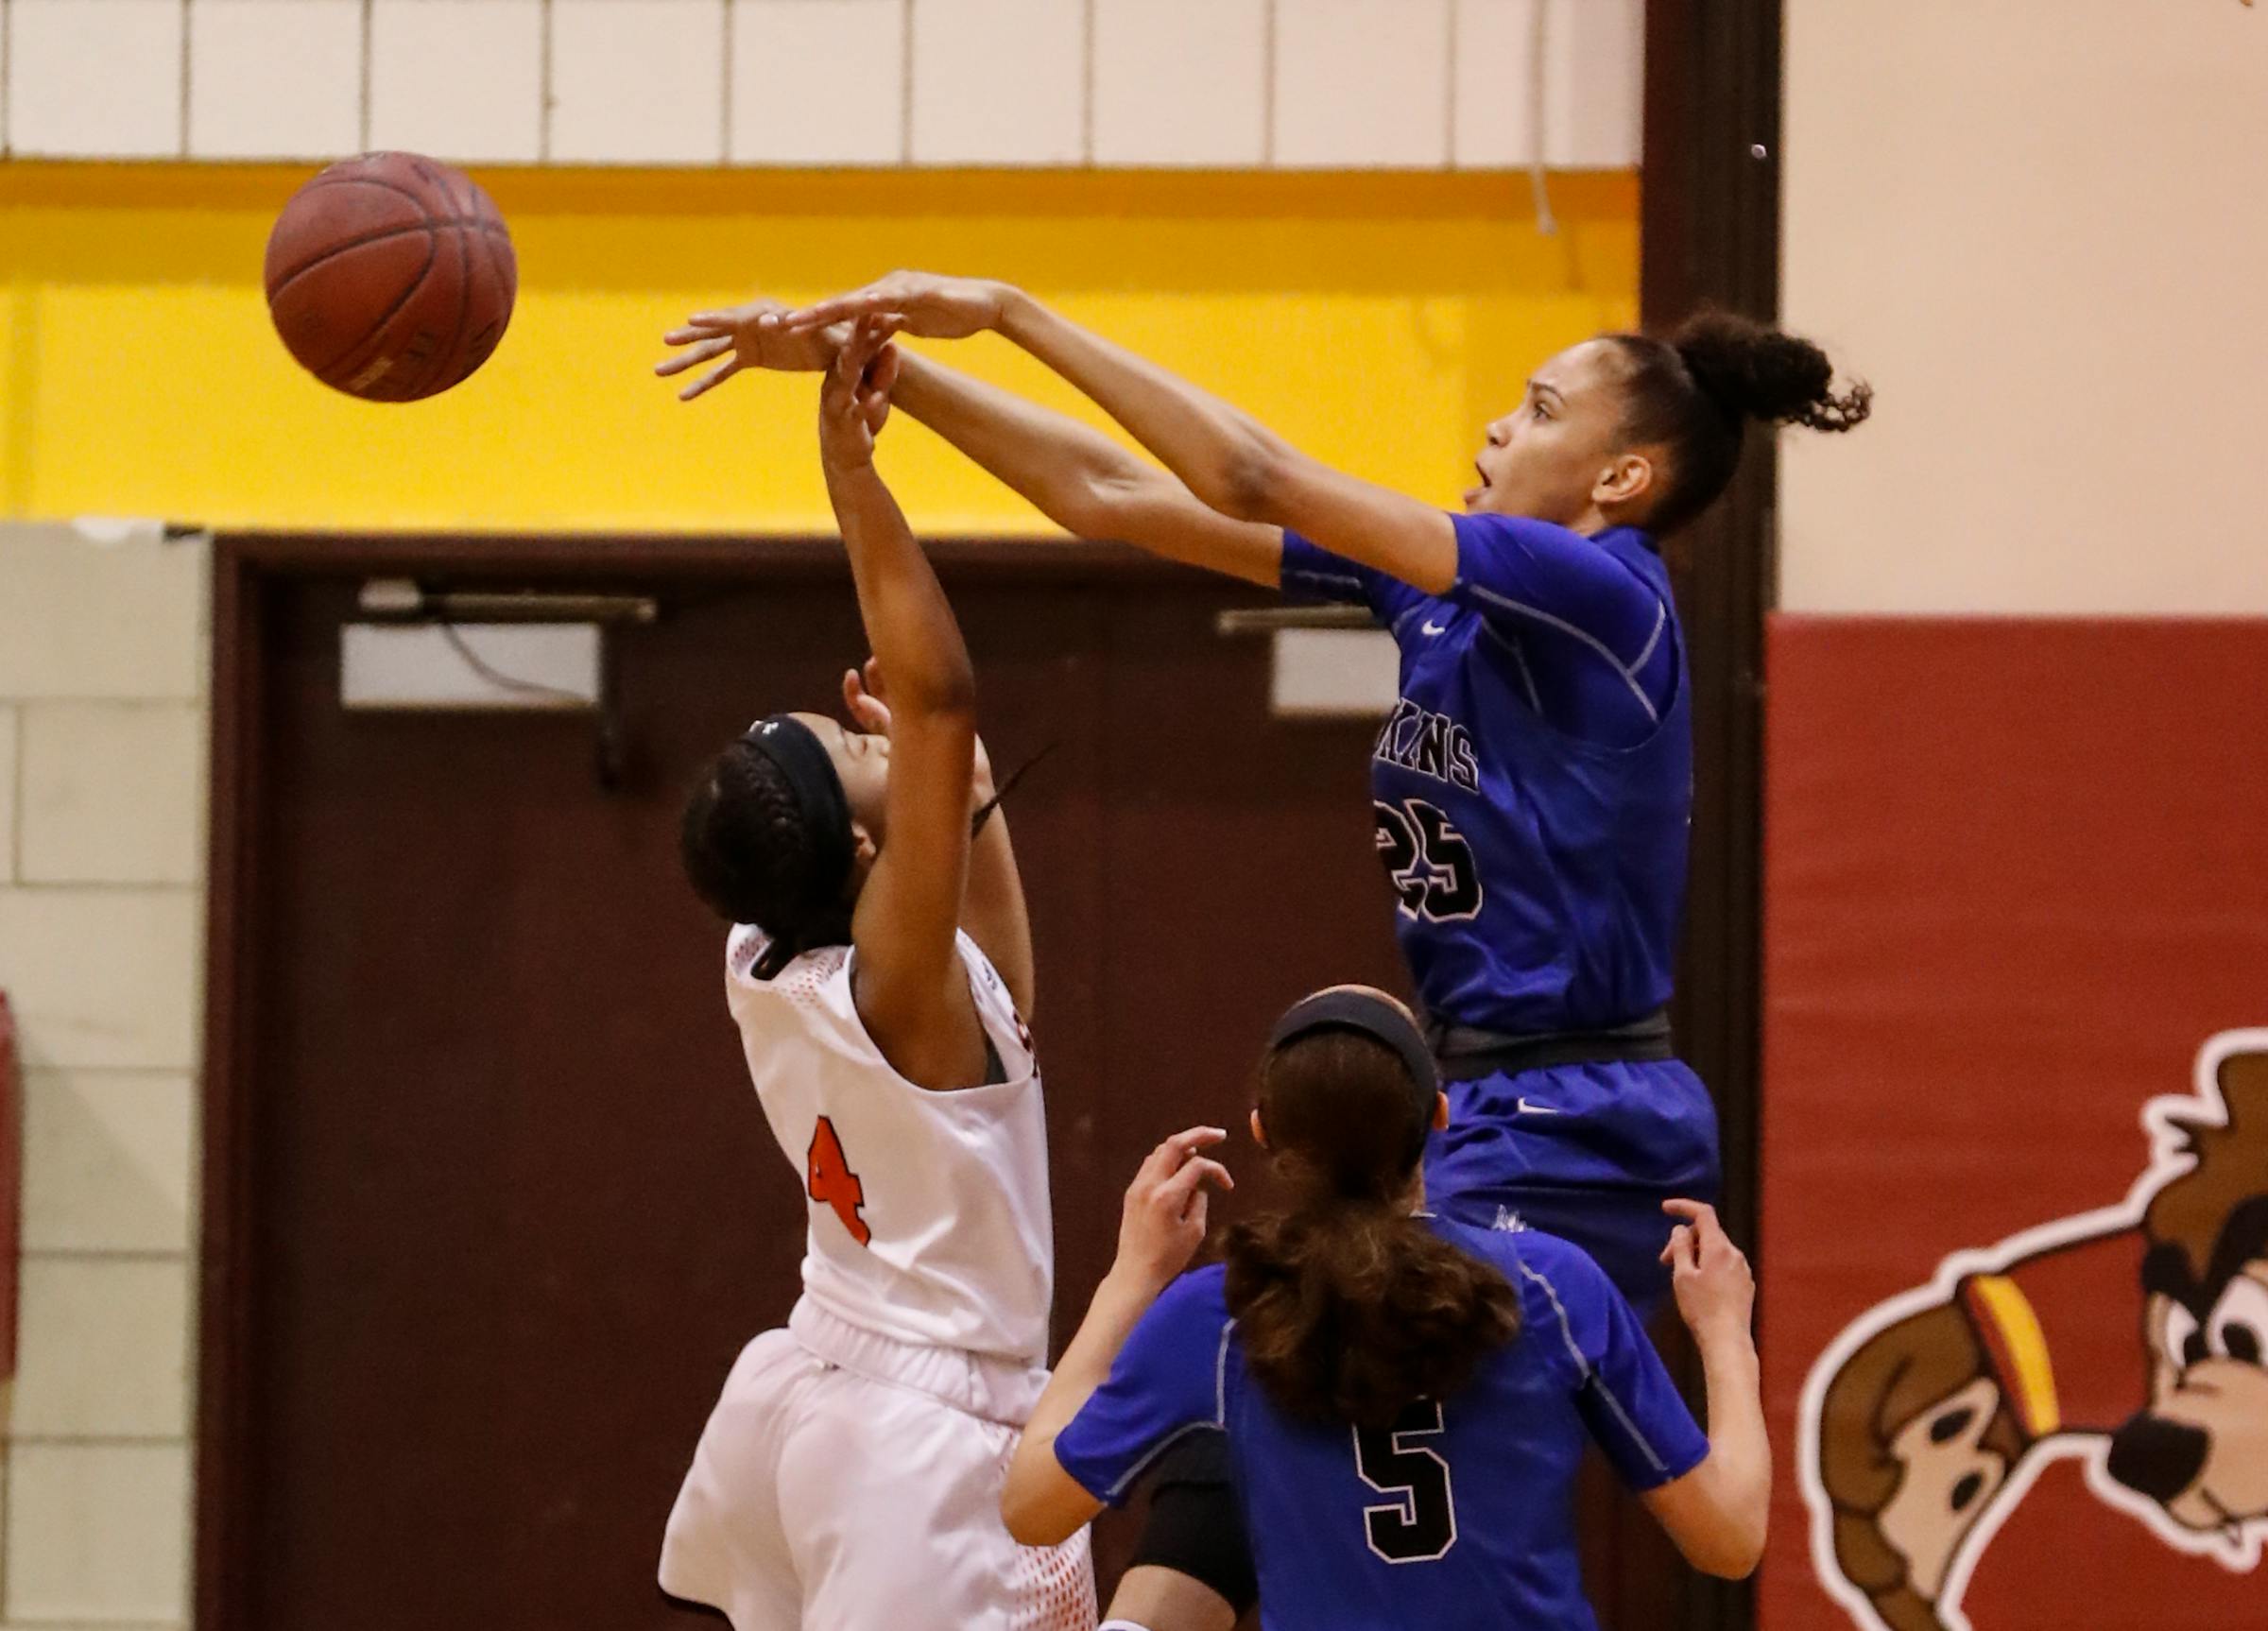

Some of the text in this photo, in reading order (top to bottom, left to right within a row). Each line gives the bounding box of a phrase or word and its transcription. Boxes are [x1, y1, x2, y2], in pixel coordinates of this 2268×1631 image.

[1373, 798, 1483, 923] 25
[807, 1114, 870, 1247] 4
[1352, 1394, 1457, 1565] 5
